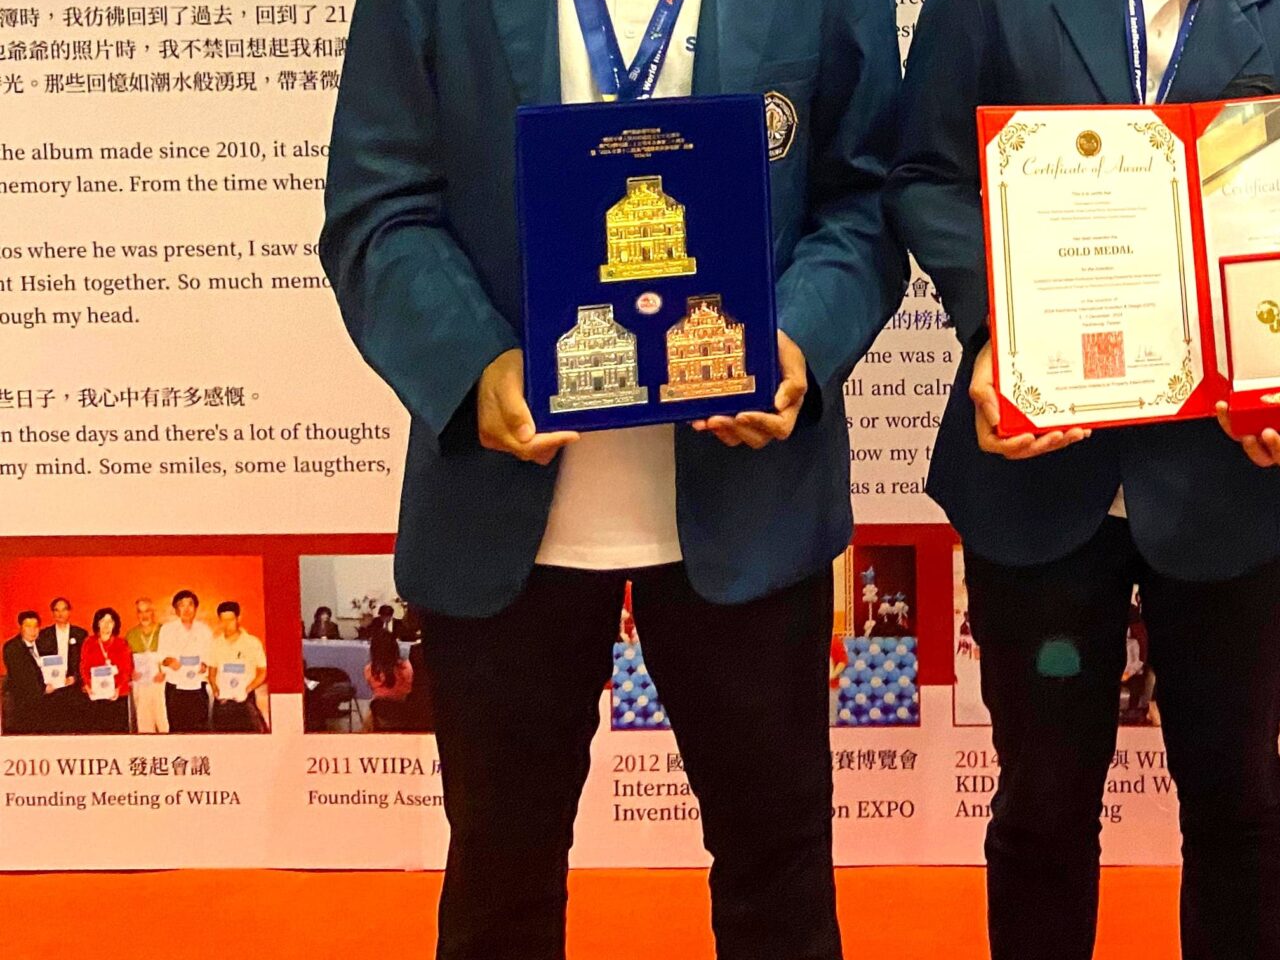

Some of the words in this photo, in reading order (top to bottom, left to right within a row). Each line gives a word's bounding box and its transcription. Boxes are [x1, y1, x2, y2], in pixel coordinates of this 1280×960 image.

[326, 6, 347, 23] 21
[1021, 155, 1087, 180] Certificate
[1089, 155, 1105, 178] of
[1111, 155, 1154, 175] Award
[1058, 246, 1091, 258] GOLD
[1094, 244, 1134, 257] MEDAL
[21, 274, 76, 291] Hsieh
[84, 273, 170, 295] together.
[178, 274, 200, 290] So
[209, 272, 263, 289] much
[53, 312, 81, 328] my
[87, 306, 139, 323] head.
[19, 426, 70, 442] those
[76, 425, 118, 446] days
[124, 425, 160, 442] and
[166, 424, 228, 441] there's
[234, 429, 244, 440] a
[250, 424, 275, 440] lot
[281, 423, 301, 440] of
[306, 422, 390, 444] thoughts
[36, 458, 91, 474] mind.
[100, 458, 152, 474] Some
[160, 457, 226, 476] smiles,
[235, 461, 286, 473] some
[294, 455, 390, 477] laugthers,
[4, 759, 50, 776] 2010
[56, 759, 122, 775] WIIPA
[129, 756, 210, 776] 發起會議
[6, 791, 86, 810] Founding
[92, 791, 160, 809] Meeting
[165, 790, 183, 805] of
[187, 791, 240, 805] WIIPA
